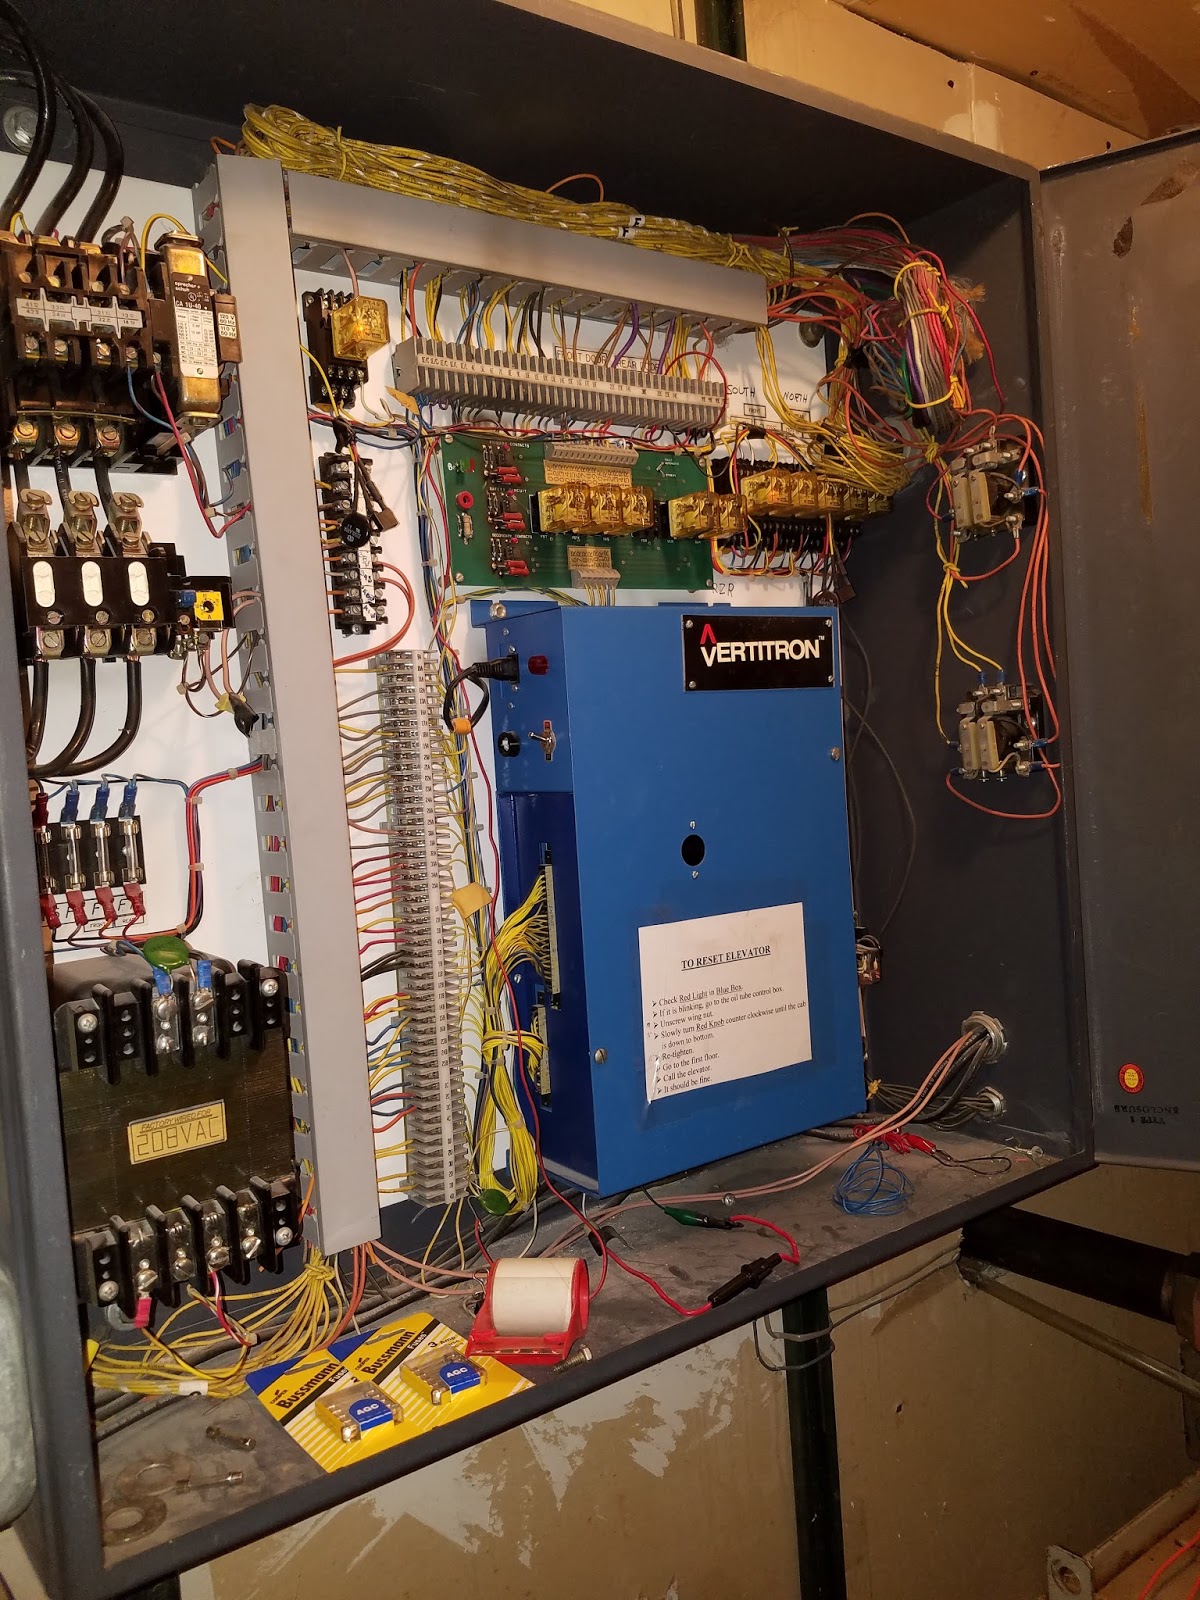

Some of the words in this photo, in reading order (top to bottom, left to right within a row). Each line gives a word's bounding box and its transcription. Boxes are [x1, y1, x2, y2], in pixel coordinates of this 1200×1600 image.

[727, 384, 755, 398] SOUTH
[784, 391, 808, 404] NORTH
[700, 639, 820, 667] VERTITRON
[681, 959, 694, 970] TO
[696, 953, 724, 966] RESET
[726, 945, 771, 961] ELEVATOR
[658, 996, 677, 1006] Check
[680, 993, 691, 1002] Red
[692, 990, 707, 1000] Light
[716, 986, 729, 995] Blue
[705, 1001, 712, 1009] go
[740, 992, 751, 1000] tube
[752, 987, 771, 997] control
[660, 1017, 686, 1027] Unscrew
[661, 1028, 681, 1038] Slowly
[696, 1022, 707, 1031] Red
[709, 1019, 724, 1027] Knob
[726, 1014, 746, 1024] counter
[747, 1008, 773, 1019] clockwise
[775, 1004, 787, 1013] until
[668, 1039, 684, 1048] down
[693, 1032, 714, 1041] bottom.
[662, 1048, 694, 1060] Re-tighten.
[704, 1052, 720, 1061] floor.
[663, 1073, 675, 1082] Call
[688, 1065, 712, 1076] elevator.
[670, 1081, 689, 1091] should
[1114, 1105, 1179, 1114] ENCLOSURE
[141, 1118, 175, 1130] FACTORY
[174, 1113, 196, 1123] WIRED
[196, 1108, 211, 1118] FOR
[361, 1331, 416, 1374] Bussmann
[328, 1368, 348, 1383] Fuse
[446, 1367, 468, 1378] AGC
[276, 1362, 339, 1409] Bussmann
[356, 1403, 379, 1415] AGC
